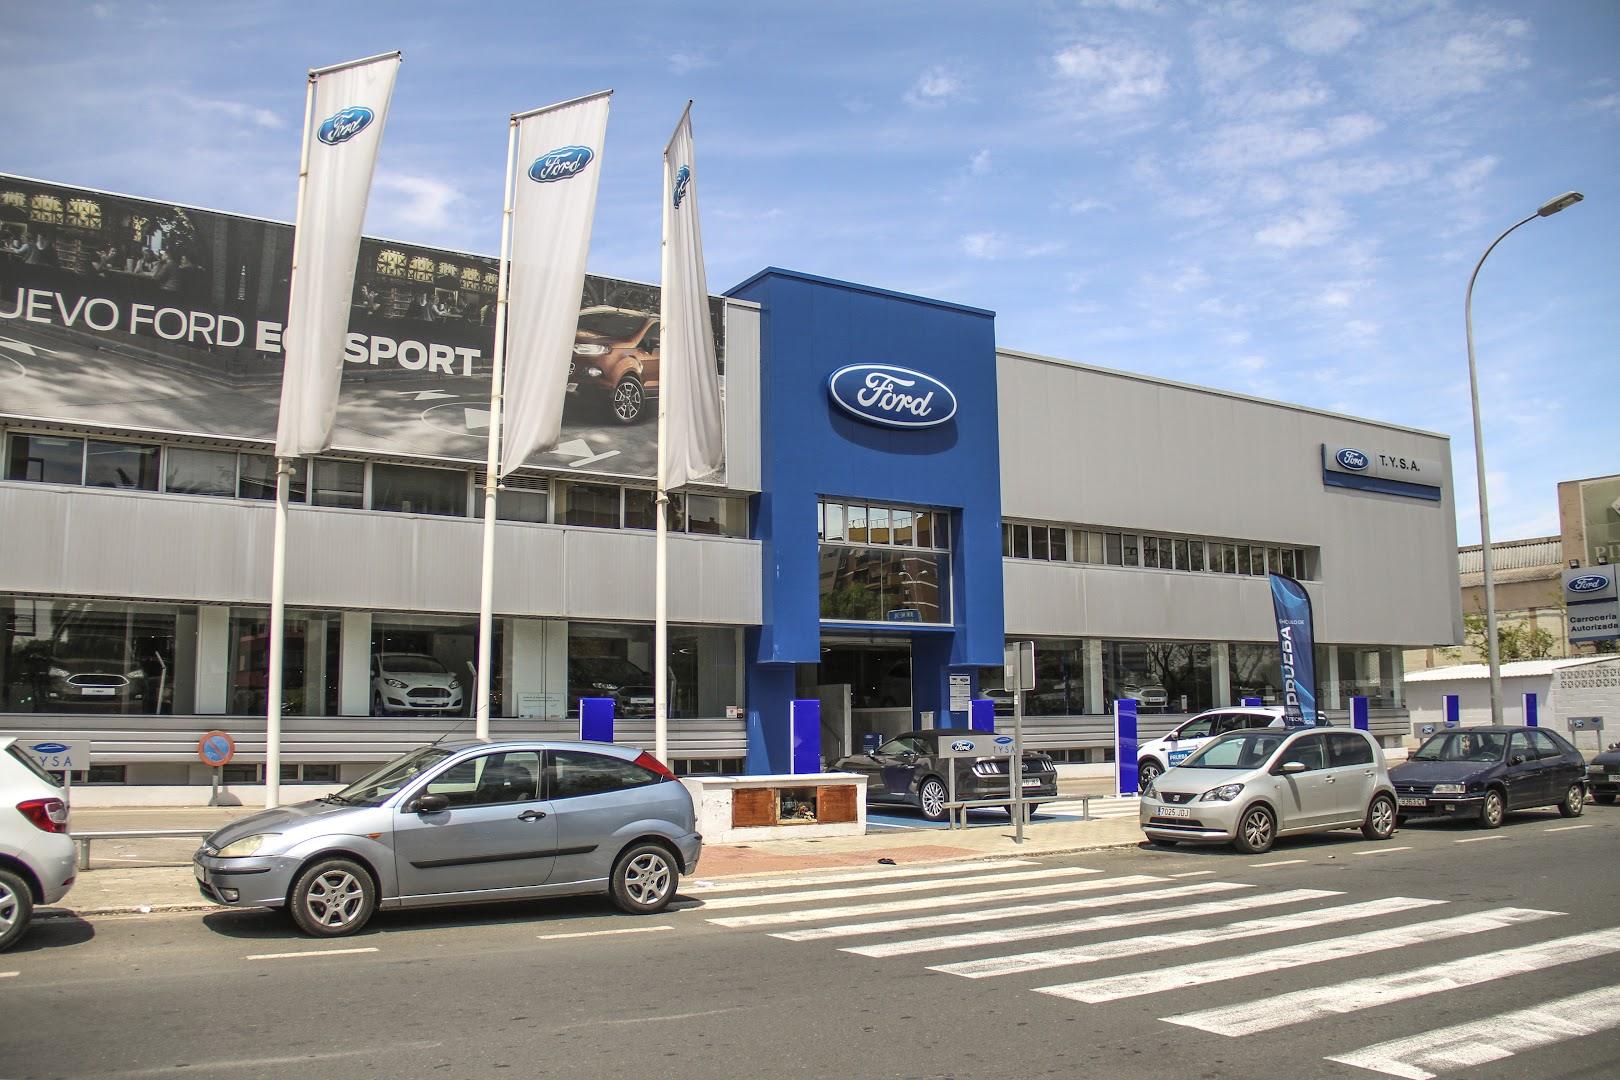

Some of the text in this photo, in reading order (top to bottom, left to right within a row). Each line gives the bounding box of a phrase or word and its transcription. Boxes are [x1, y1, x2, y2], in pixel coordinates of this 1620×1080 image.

[328, 112, 364, 140] Ford
[540, 151, 582, 178] Ford
[130, 303, 244, 347] FORD
[255, 320, 481, 377] ESPORT
[857, 372, 934, 417] Ford
[1344, 451, 1364, 465] Ford
[1575, 578, 1600, 590] Ford
[1571, 623, 1619, 632] Autorizada
[31, 756, 72, 767] YSA
